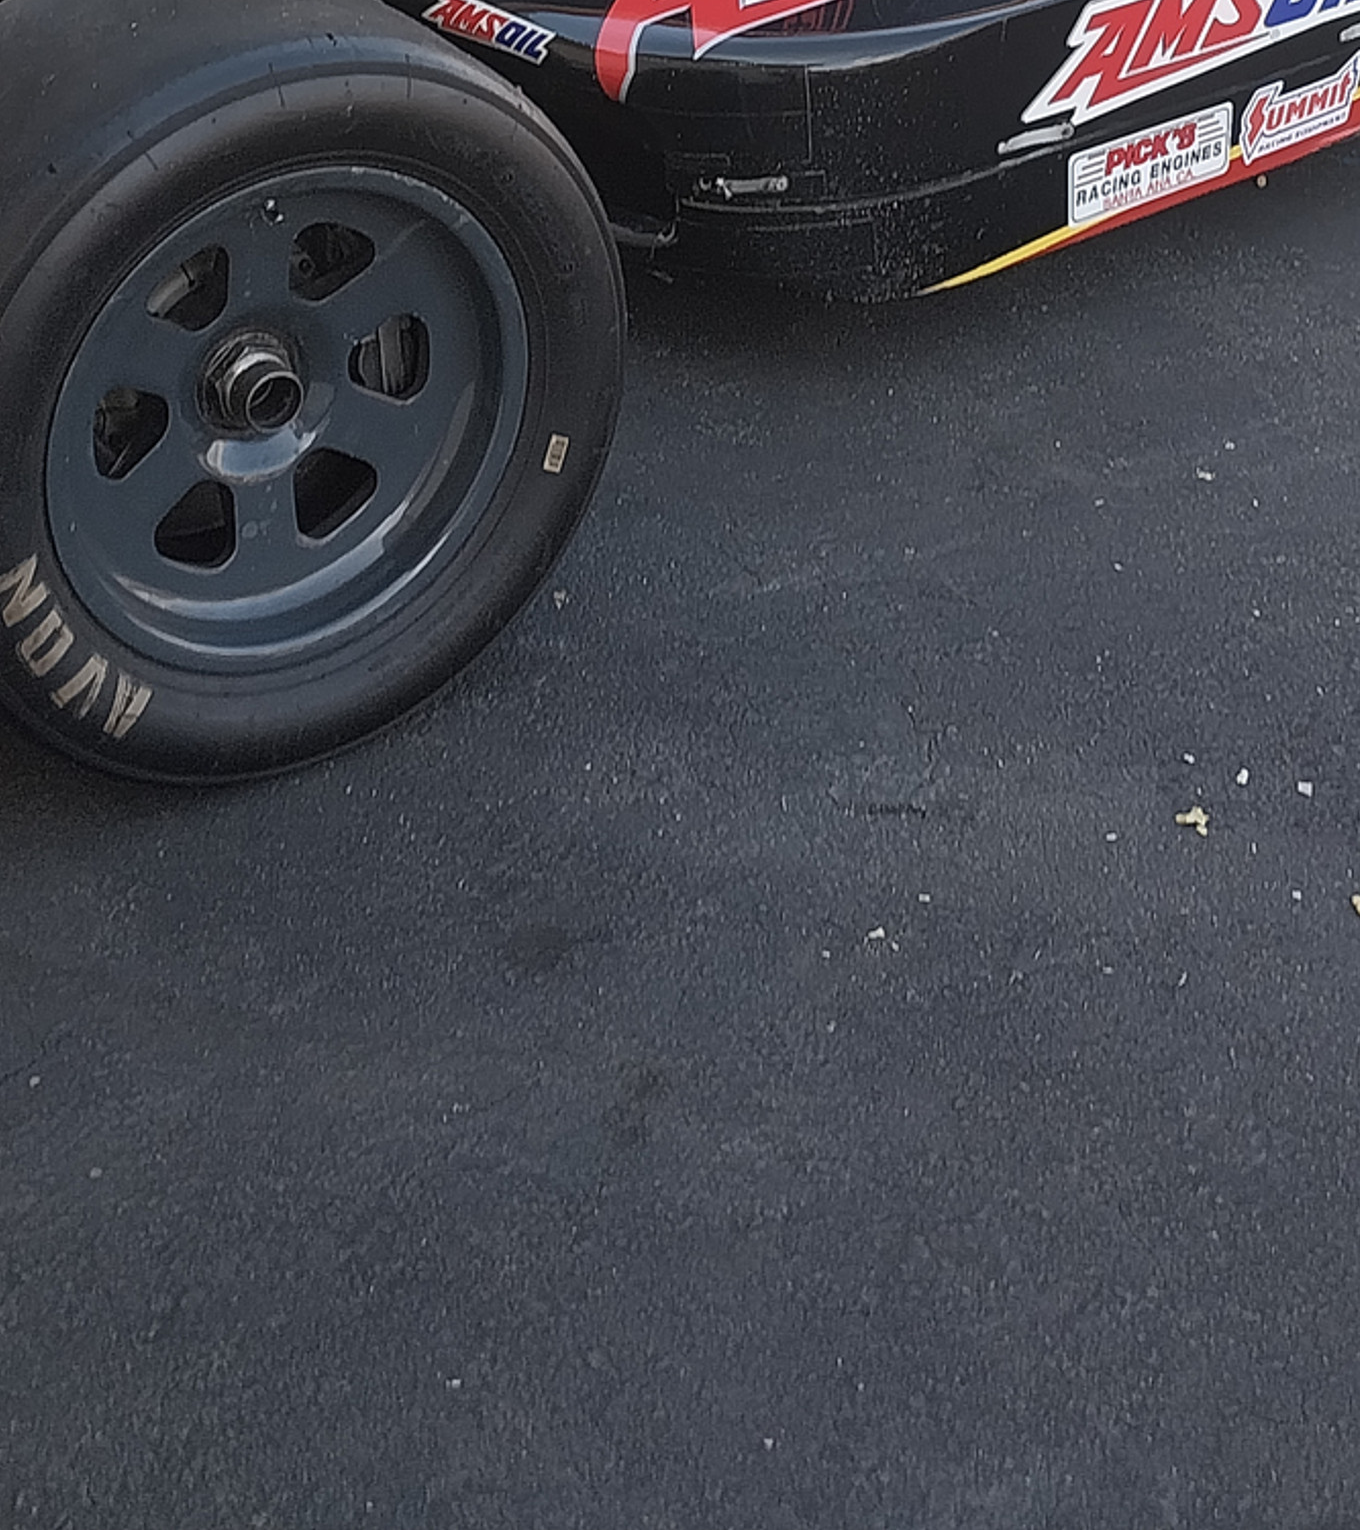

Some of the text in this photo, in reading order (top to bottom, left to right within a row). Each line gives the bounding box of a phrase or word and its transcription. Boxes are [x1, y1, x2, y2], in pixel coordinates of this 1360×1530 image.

[1075, 140, 1223, 208] RACING ENGINES
[1104, 122, 1198, 177] PICK'S
[1102, 186, 1144, 211] SANTA
[1146, 176, 1172, 195] ANA
